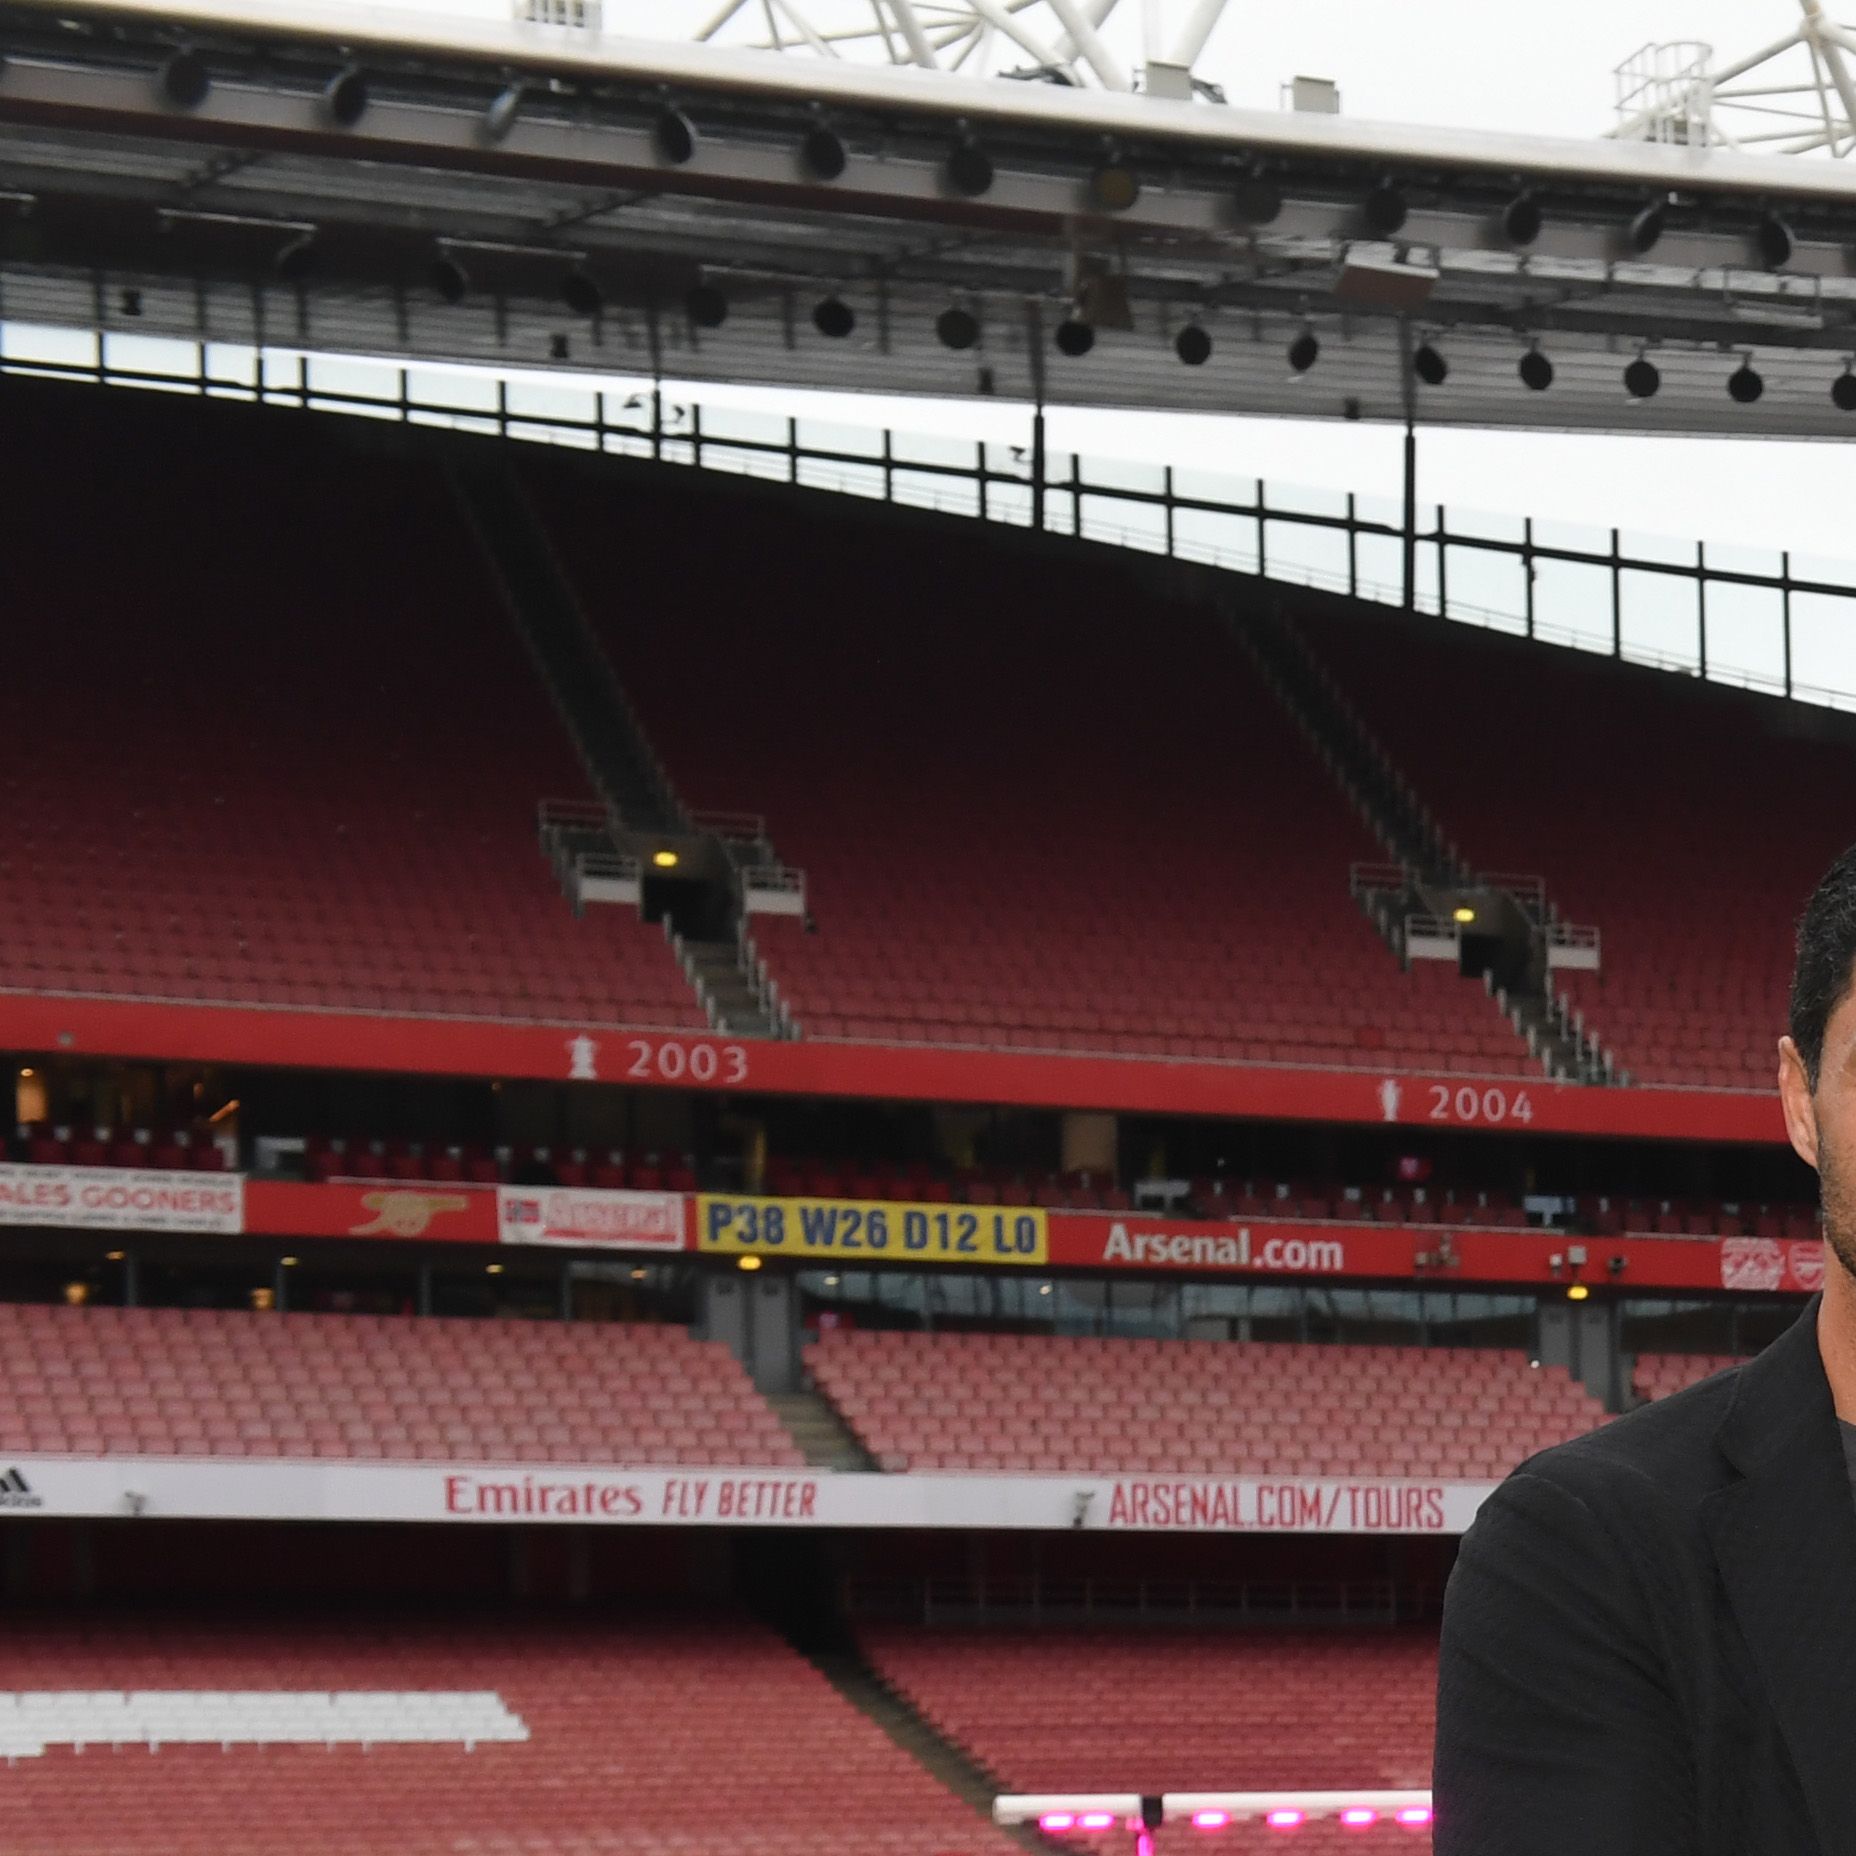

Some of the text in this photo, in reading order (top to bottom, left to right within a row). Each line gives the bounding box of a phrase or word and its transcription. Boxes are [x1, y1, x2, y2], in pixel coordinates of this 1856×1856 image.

[626, 1039, 748, 1083] 2003
[1429, 1085, 1533, 1123] 2004
[80, 1184, 235, 1213] GOONERS
[707, 1203, 785, 1245] P38
[800, 1207, 889, 1250] W26
[904, 1211, 978, 1253] D12
[1103, 1222, 1344, 1271] Arsenal.com
[444, 1475, 817, 1518] Emirates FLY BETTER
[1109, 1482, 1445, 1530] ARSENAL.COM/TOURS
